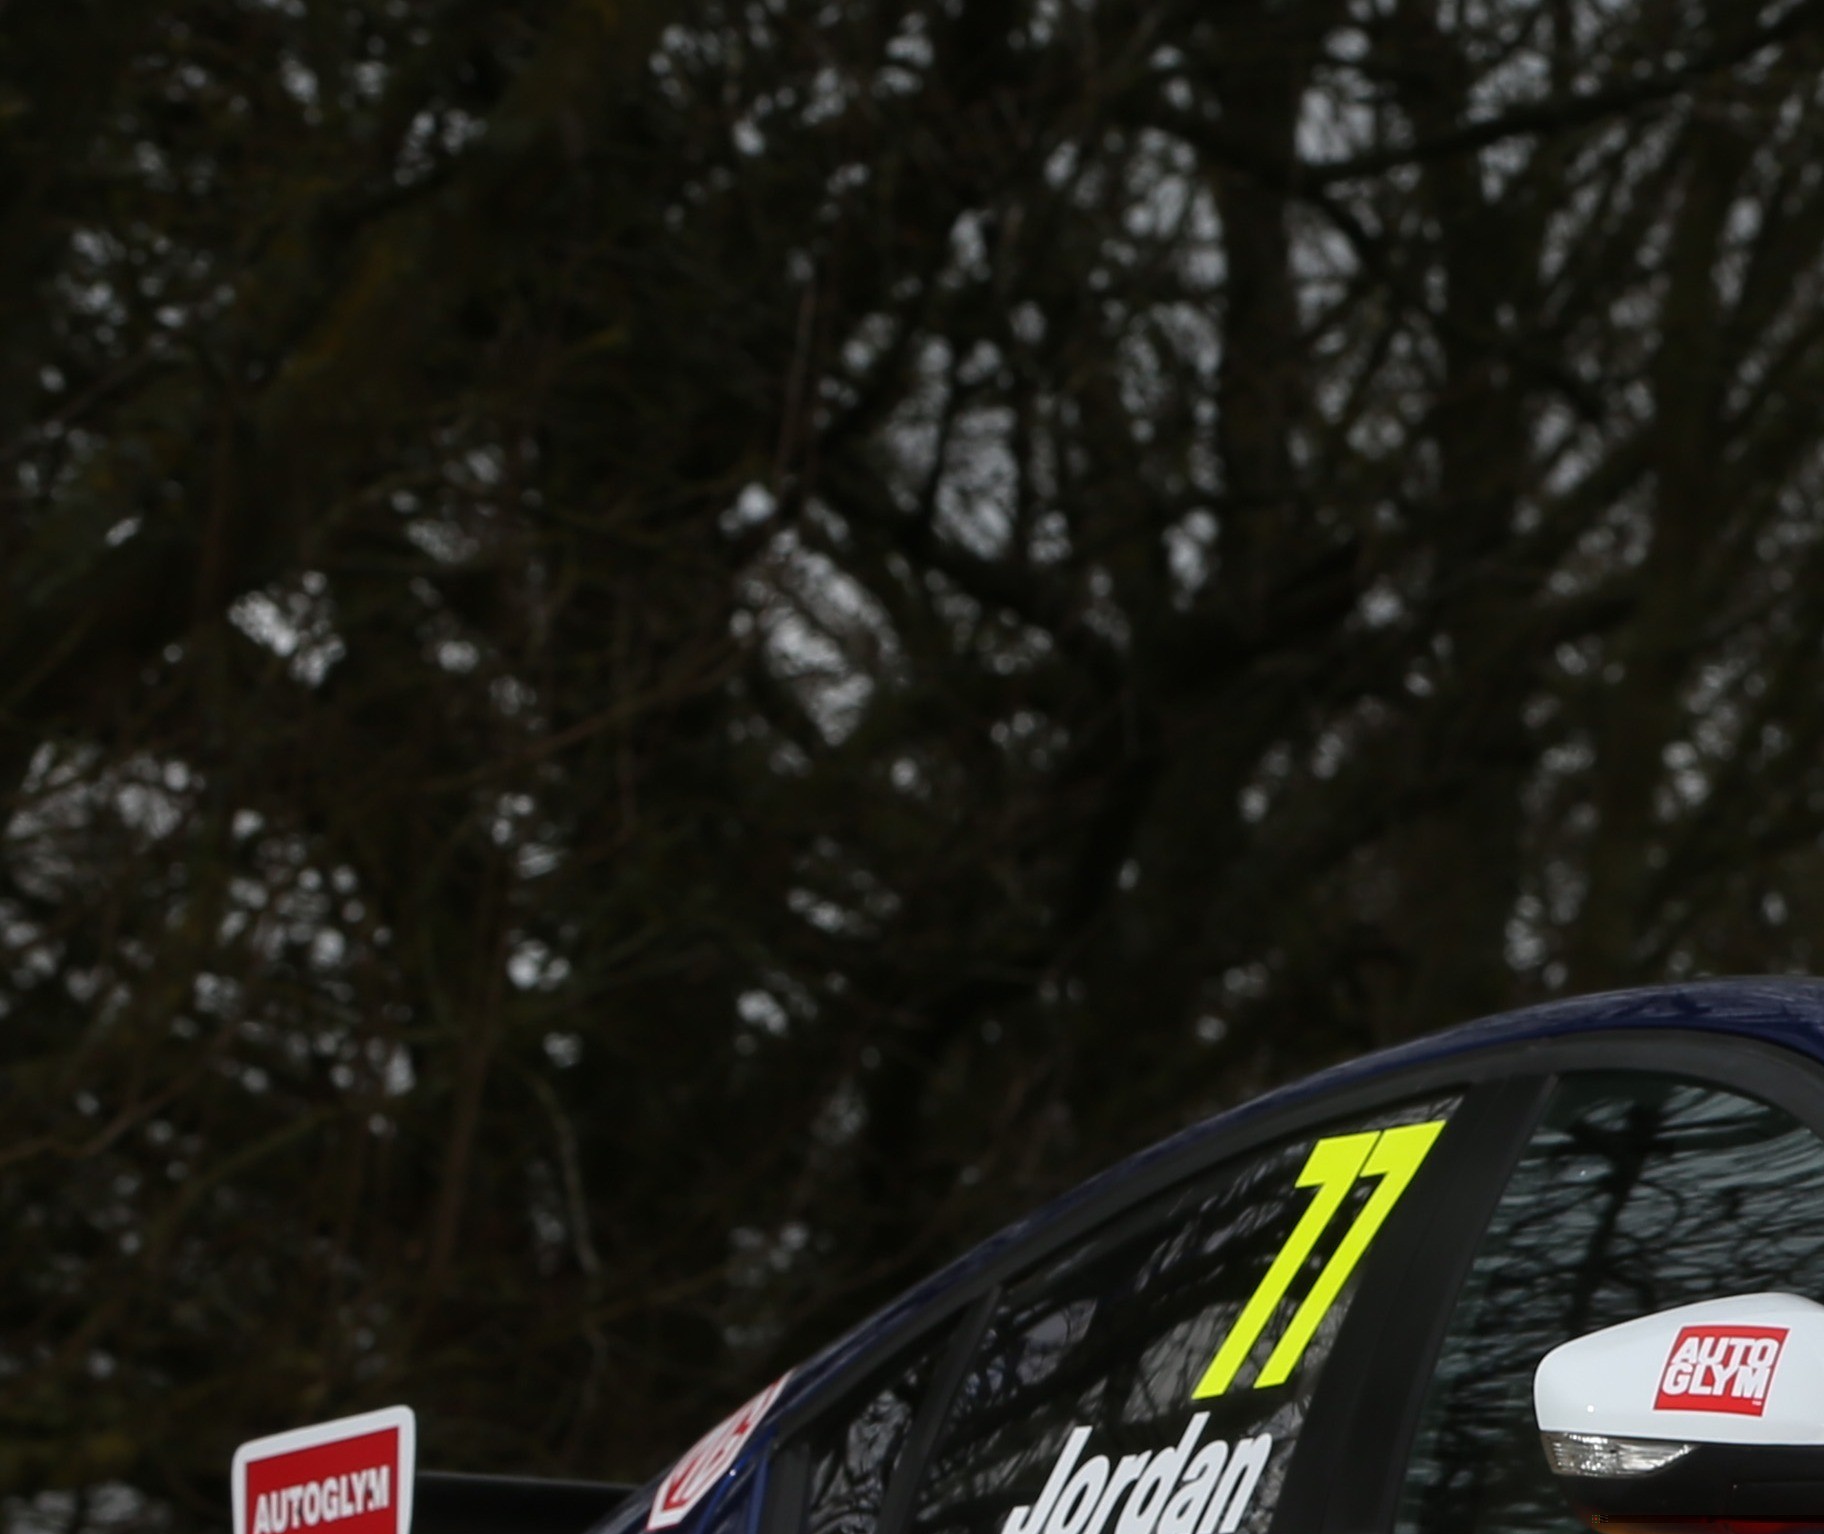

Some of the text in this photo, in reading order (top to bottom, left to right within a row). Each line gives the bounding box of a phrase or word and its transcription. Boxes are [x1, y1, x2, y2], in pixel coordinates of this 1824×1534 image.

[1190, 1119, 1448, 1400] 77
[1670, 1336, 1780, 1369] AUTO
[1661, 1361, 1771, 1400] GLYM
